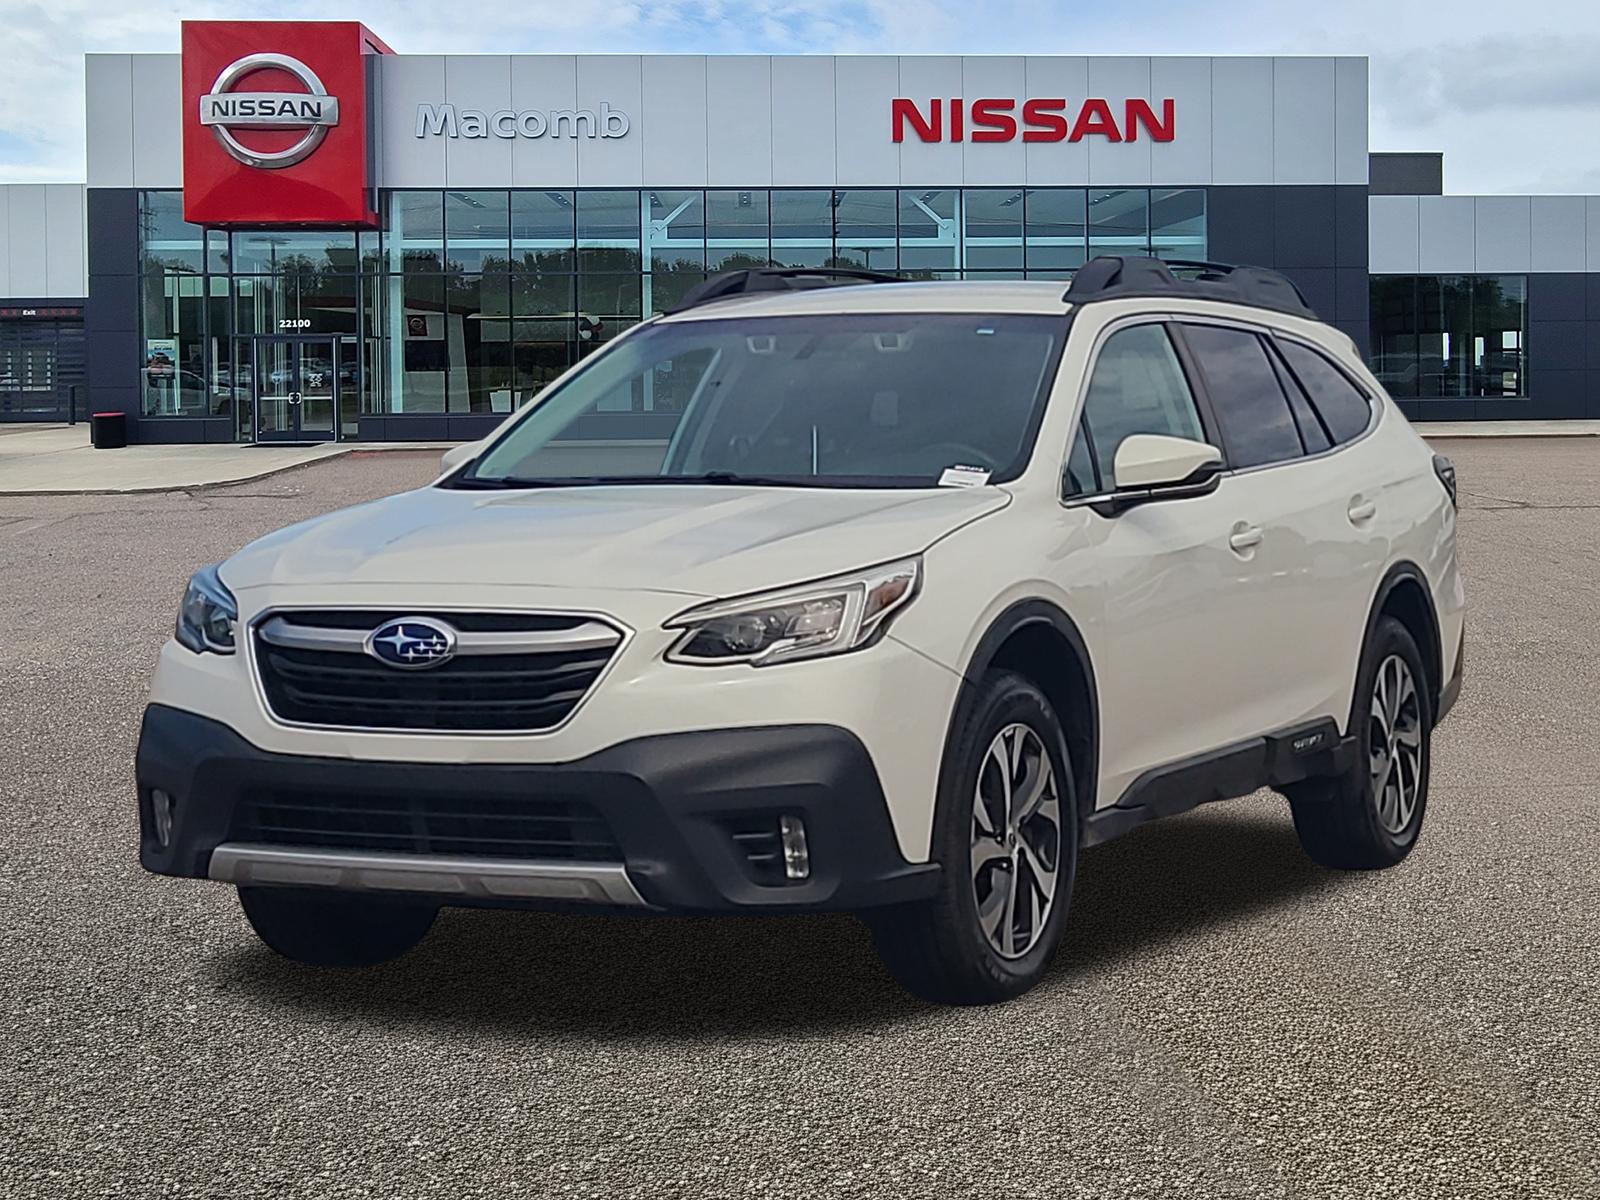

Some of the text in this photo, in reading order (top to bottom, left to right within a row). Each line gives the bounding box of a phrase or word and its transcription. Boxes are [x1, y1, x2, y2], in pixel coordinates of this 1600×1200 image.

[212, 100, 322, 117] NISSAN
[415, 102, 630, 138] Macomb
[892, 98, 1175, 143] NISSAN
[279, 319, 311, 328] 22100
